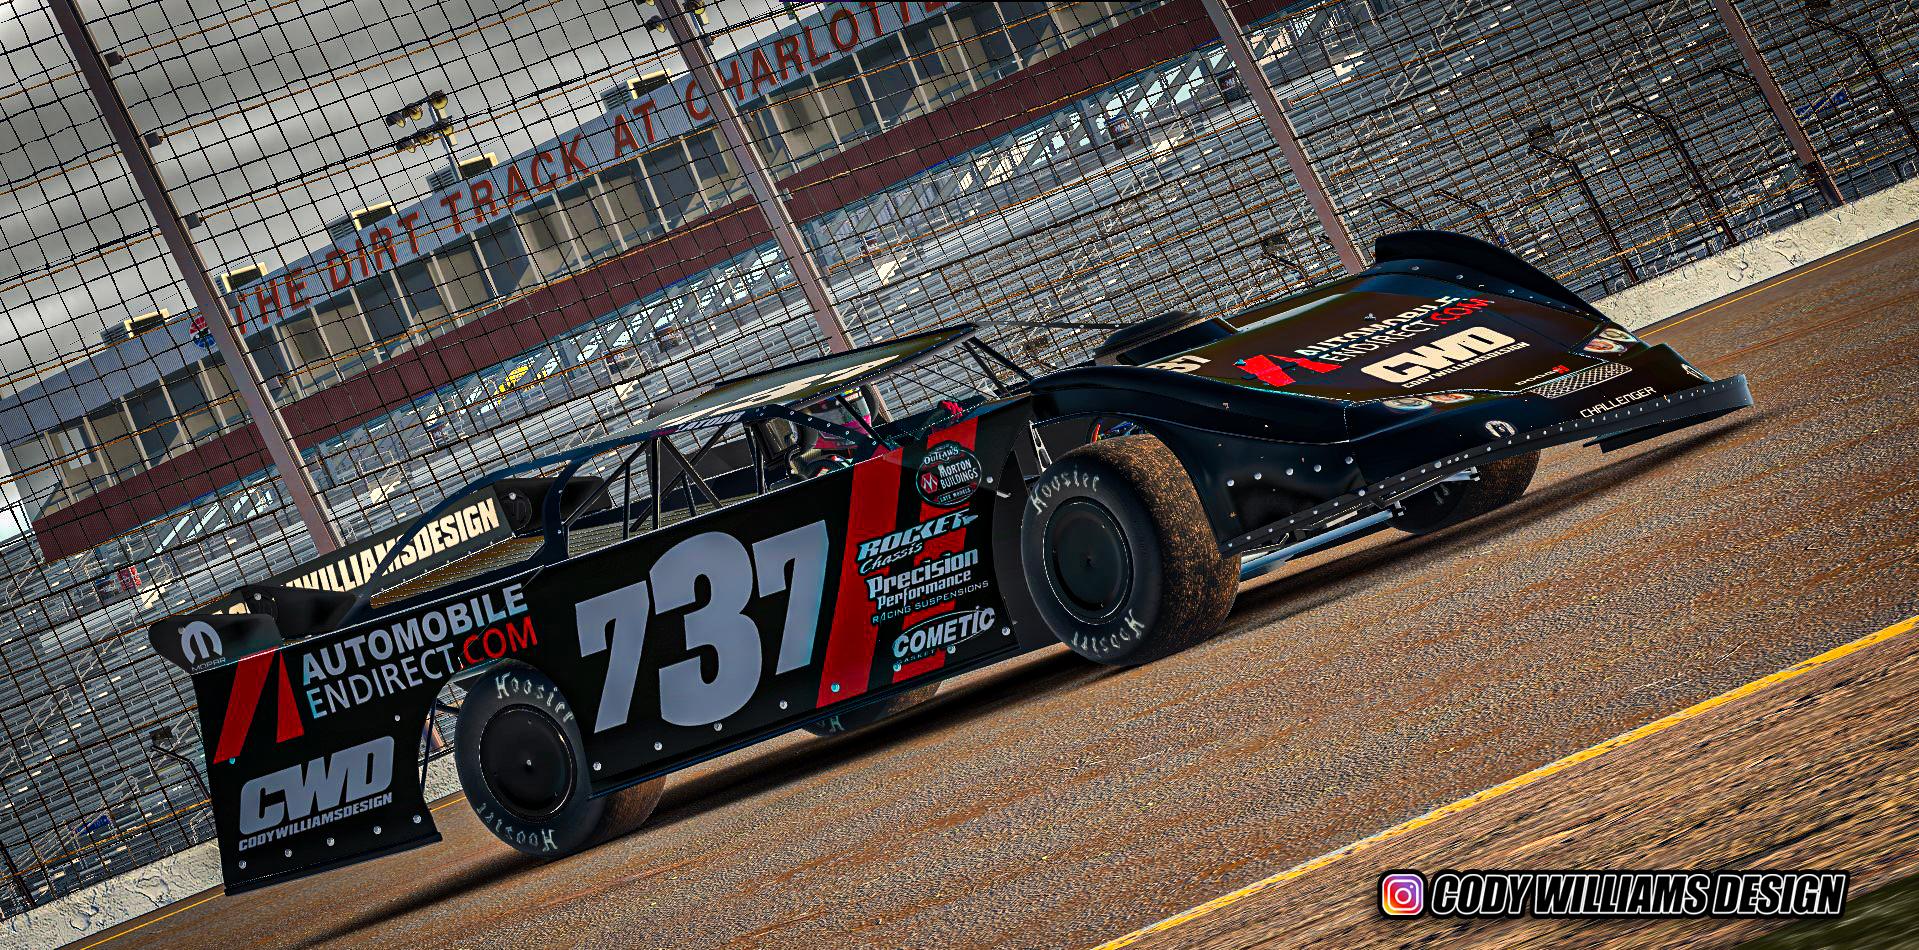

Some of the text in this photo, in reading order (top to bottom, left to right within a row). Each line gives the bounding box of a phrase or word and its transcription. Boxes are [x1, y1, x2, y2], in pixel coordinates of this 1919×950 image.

[237, 2, 949, 334] THE DIRT TRACK AT CHARLOT
[1361, 326, 1516, 383] CWD
[1580, 386, 1657, 418] CHALLENGER
[924, 446, 959, 465] OUTLAWS
[938, 459, 972, 478] MORTON
[940, 468, 979, 489] BUILDINGS
[857, 508, 979, 561] ROCKET
[859, 542, 923, 574] Chassis
[866, 548, 979, 599] Precision
[877, 569, 972, 610] Performance
[575, 520, 829, 733] 737
[872, 580, 989, 624] RACING SUSPENSIONS
[303, 584, 529, 686] AUTOMOBILE
[892, 606, 995, 658] COMETIC
[192, 656, 226, 672] MOPAR
[495, 672, 575, 723] Hoosier
[239, 736, 395, 835] CWD
[239, 792, 392, 852] CODYWILLIAMSDESIGN
